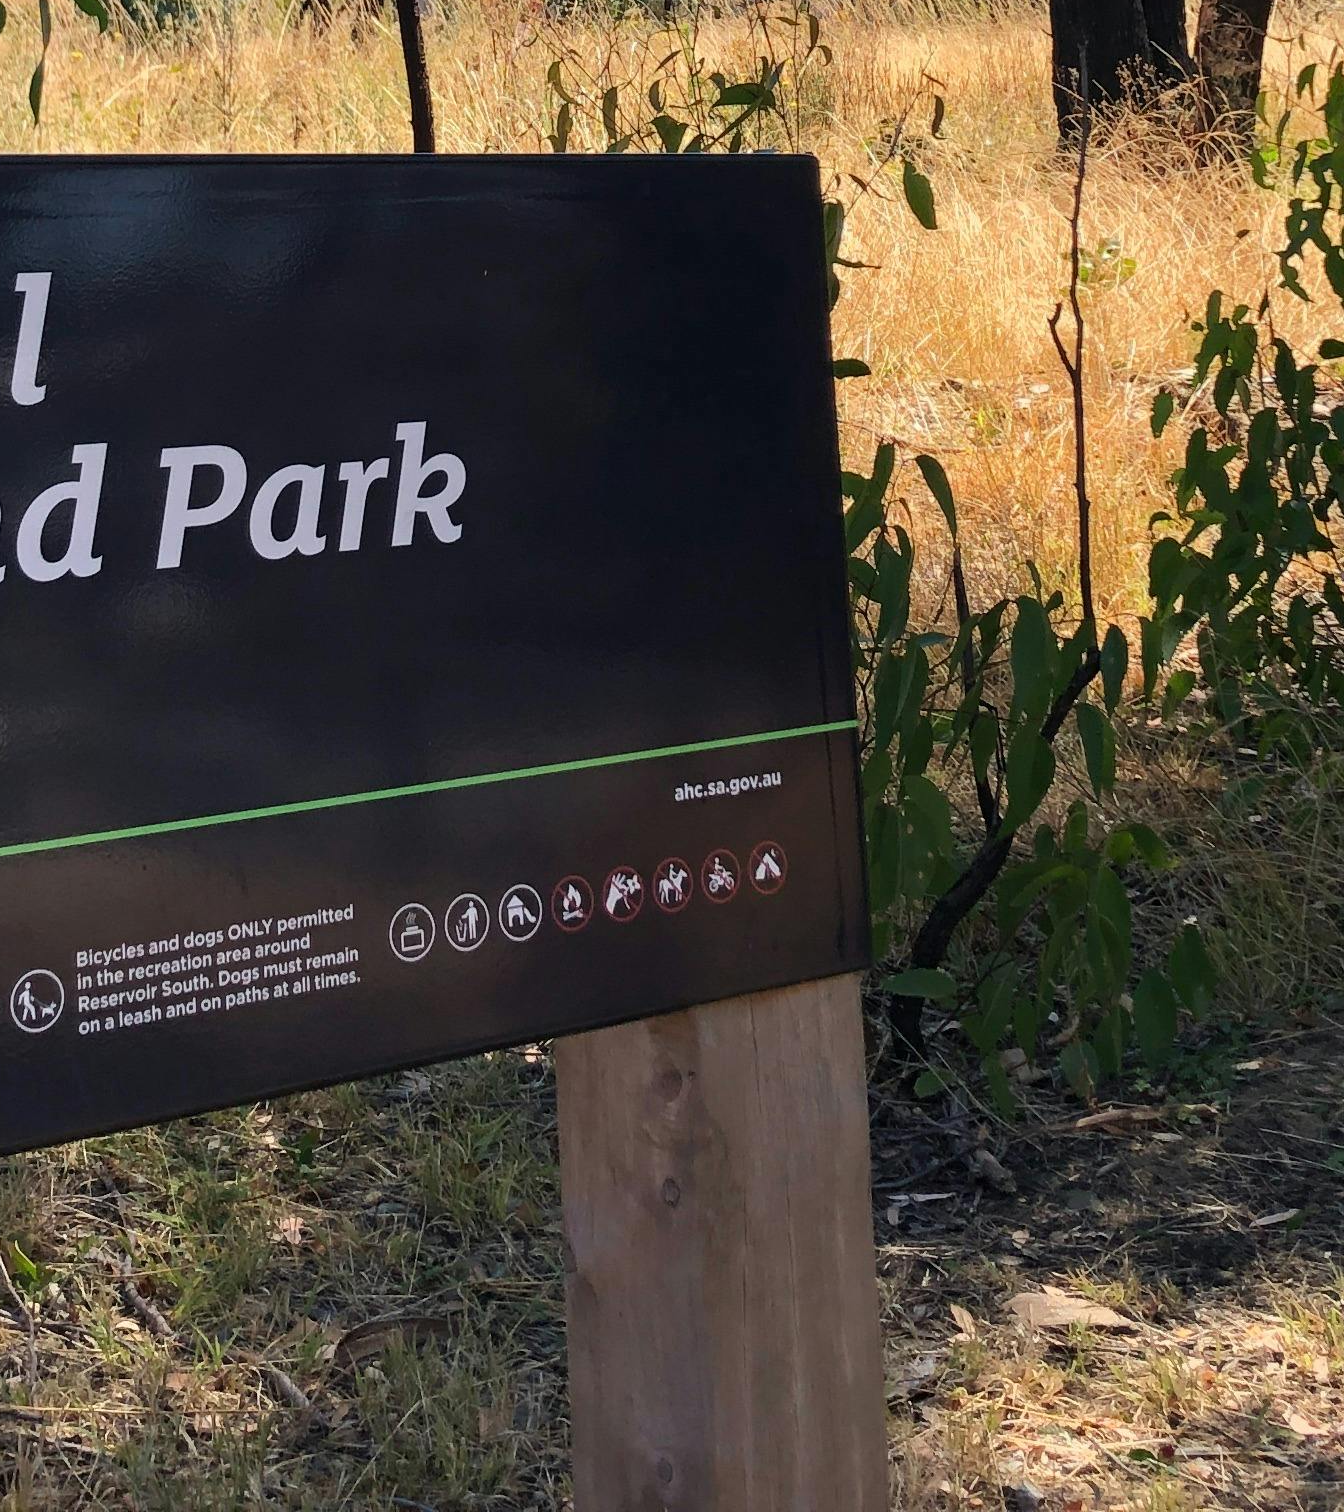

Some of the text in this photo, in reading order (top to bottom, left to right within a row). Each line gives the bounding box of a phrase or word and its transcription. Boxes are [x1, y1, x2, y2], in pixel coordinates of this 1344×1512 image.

[156, 421, 466, 569] Park
[674, 771, 782, 802] ahc.sa.gov.au
[76, 903, 354, 968] Bicycles and dogs ONLY permitted
[76, 932, 311, 991] in the recreation area around
[78, 947, 359, 1013] Reservoir South. Dogs must remain
[78, 970, 361, 1035] on a leash and on paths at all times.
